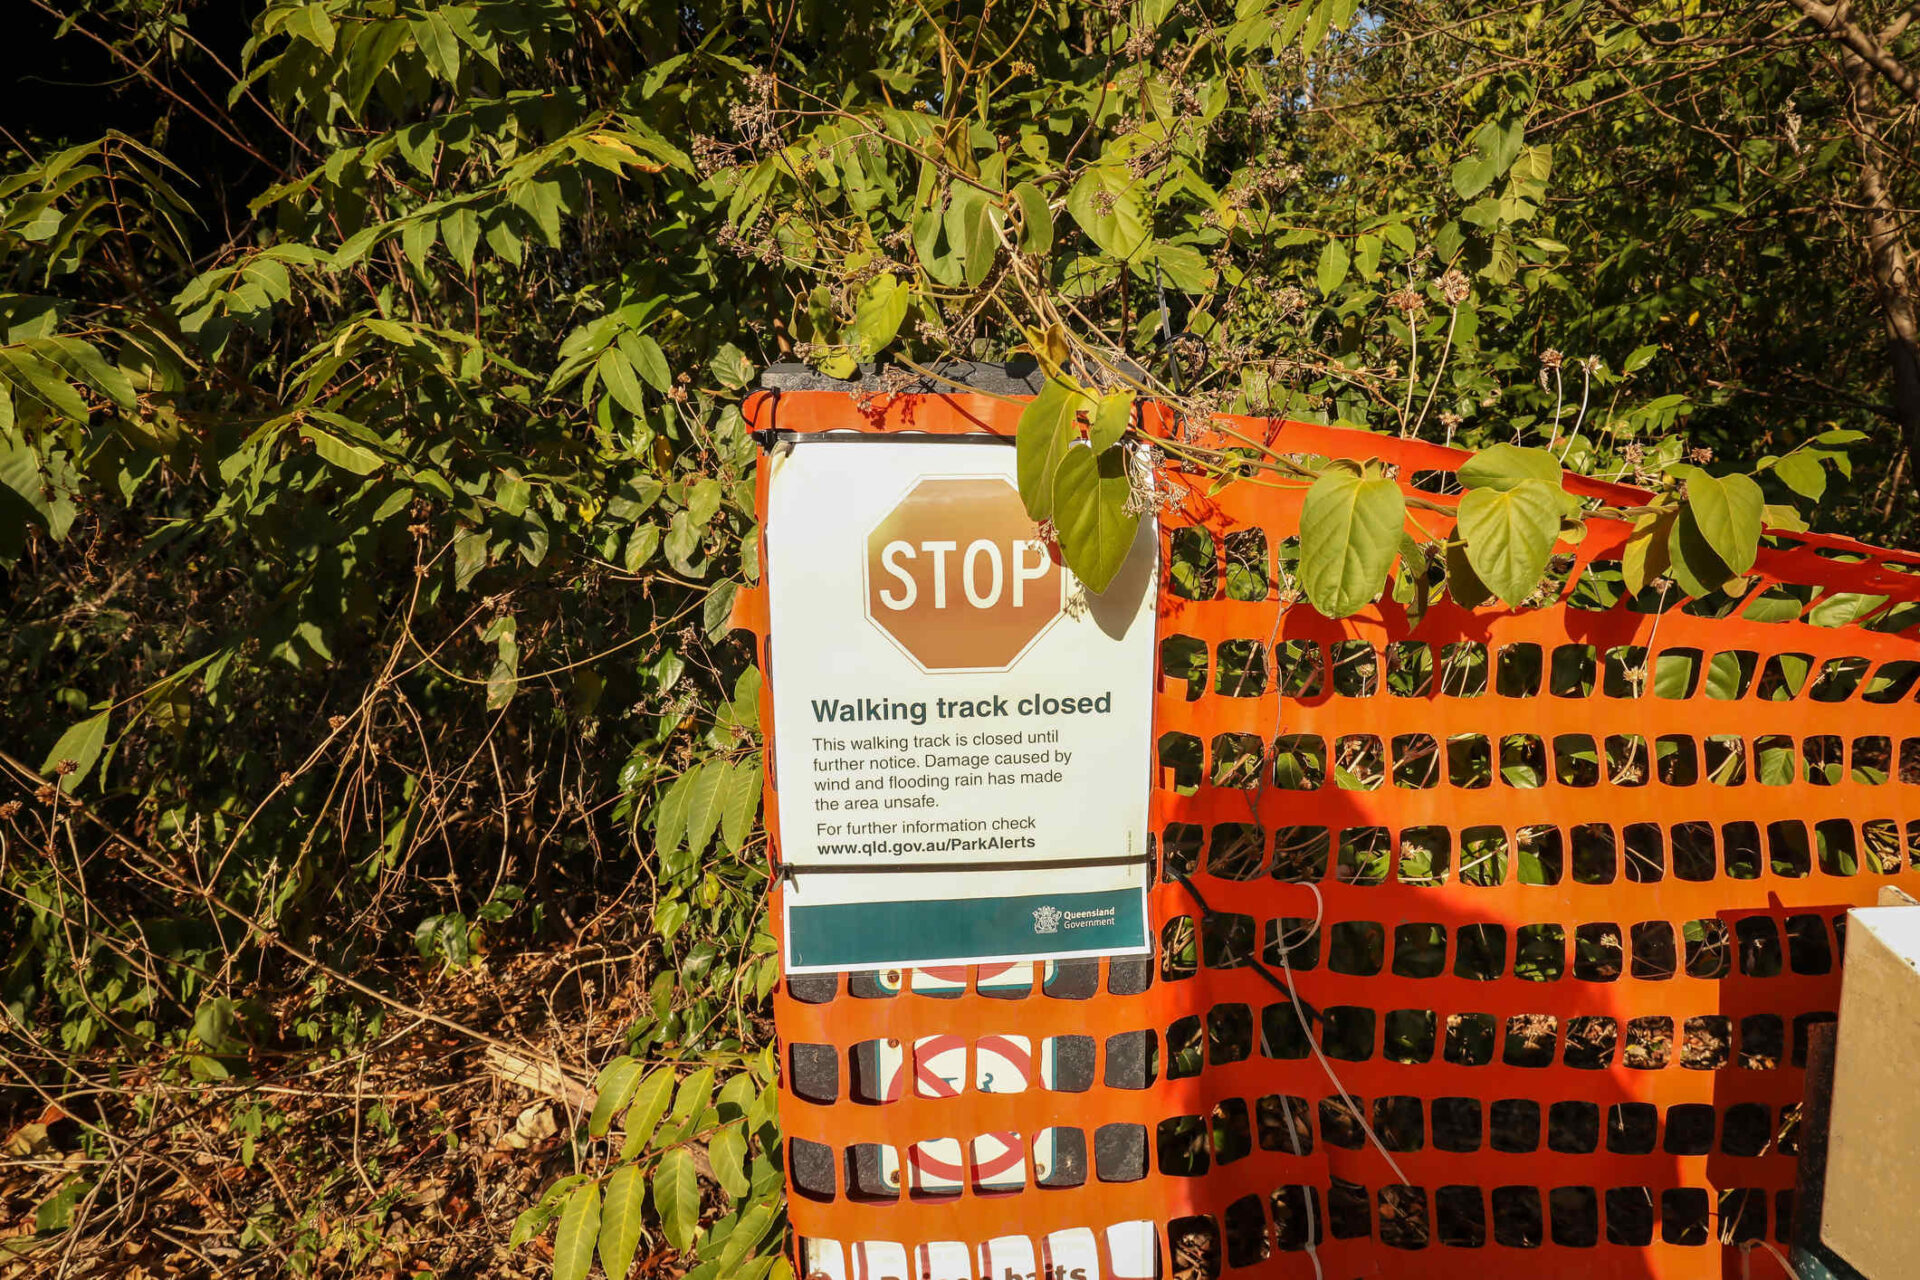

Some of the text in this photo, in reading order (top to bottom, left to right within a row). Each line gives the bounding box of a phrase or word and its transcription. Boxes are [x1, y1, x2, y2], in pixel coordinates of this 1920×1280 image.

[879, 539, 1051, 611] STOP
[811, 691, 1112, 725] Walking track closed
[812, 729, 1059, 752] This walking track is closed until
[813, 750, 1072, 772] further notice. Damage caused by
[814, 769, 1063, 792] wind and flooding rain has made
[815, 794, 939, 811] the area unsafe.
[817, 816, 1036, 836] For further information check
[817, 835, 1036, 857] www.qld.gov.au/ParkAlerts
[1063, 906, 1115, 921] Queensland
[1063, 917, 1115, 929] Government
